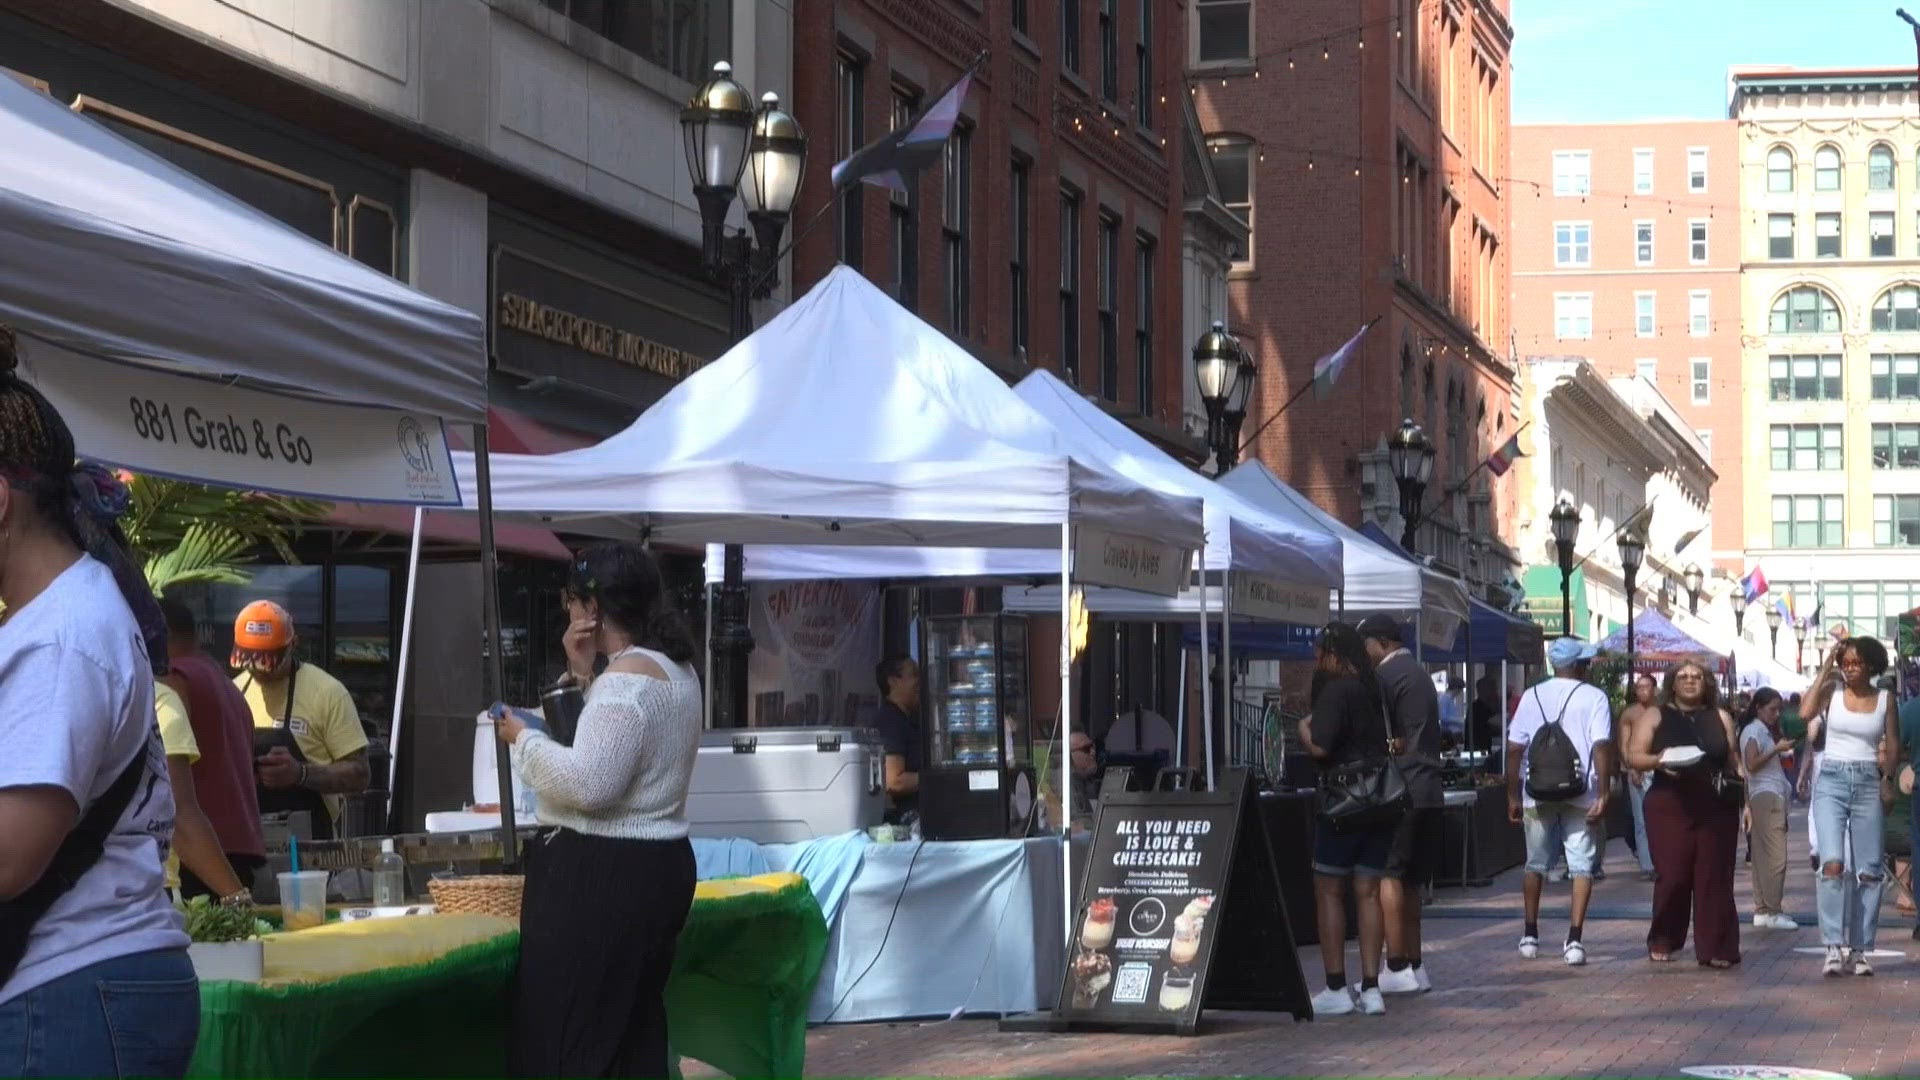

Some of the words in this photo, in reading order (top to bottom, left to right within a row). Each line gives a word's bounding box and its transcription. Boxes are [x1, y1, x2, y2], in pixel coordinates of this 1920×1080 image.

[503, 293, 614, 357] STACKPOLE
[617, 330, 680, 379] MOORE
[129, 395, 178, 444] 881
[184, 406, 248, 455] Grab
[252, 418, 273, 460] &
[276, 423, 313, 465] Go
[1103, 542, 1129, 569] Craves
[1139, 547, 1160, 576] Aves
[1116, 820, 1139, 834] ALL
[1145, 820, 1172, 834] YOU
[1175, 820, 1211, 834] NEED
[1126, 836, 1139, 850] IS
[1144, 836, 1180, 850] LOVE
[1184, 836, 1195, 850] &
[1112, 852, 1202, 866] CHEESECAKE!
[1178, 879, 1189, 887] JAR
[1172, 887, 1190, 896] Apple
